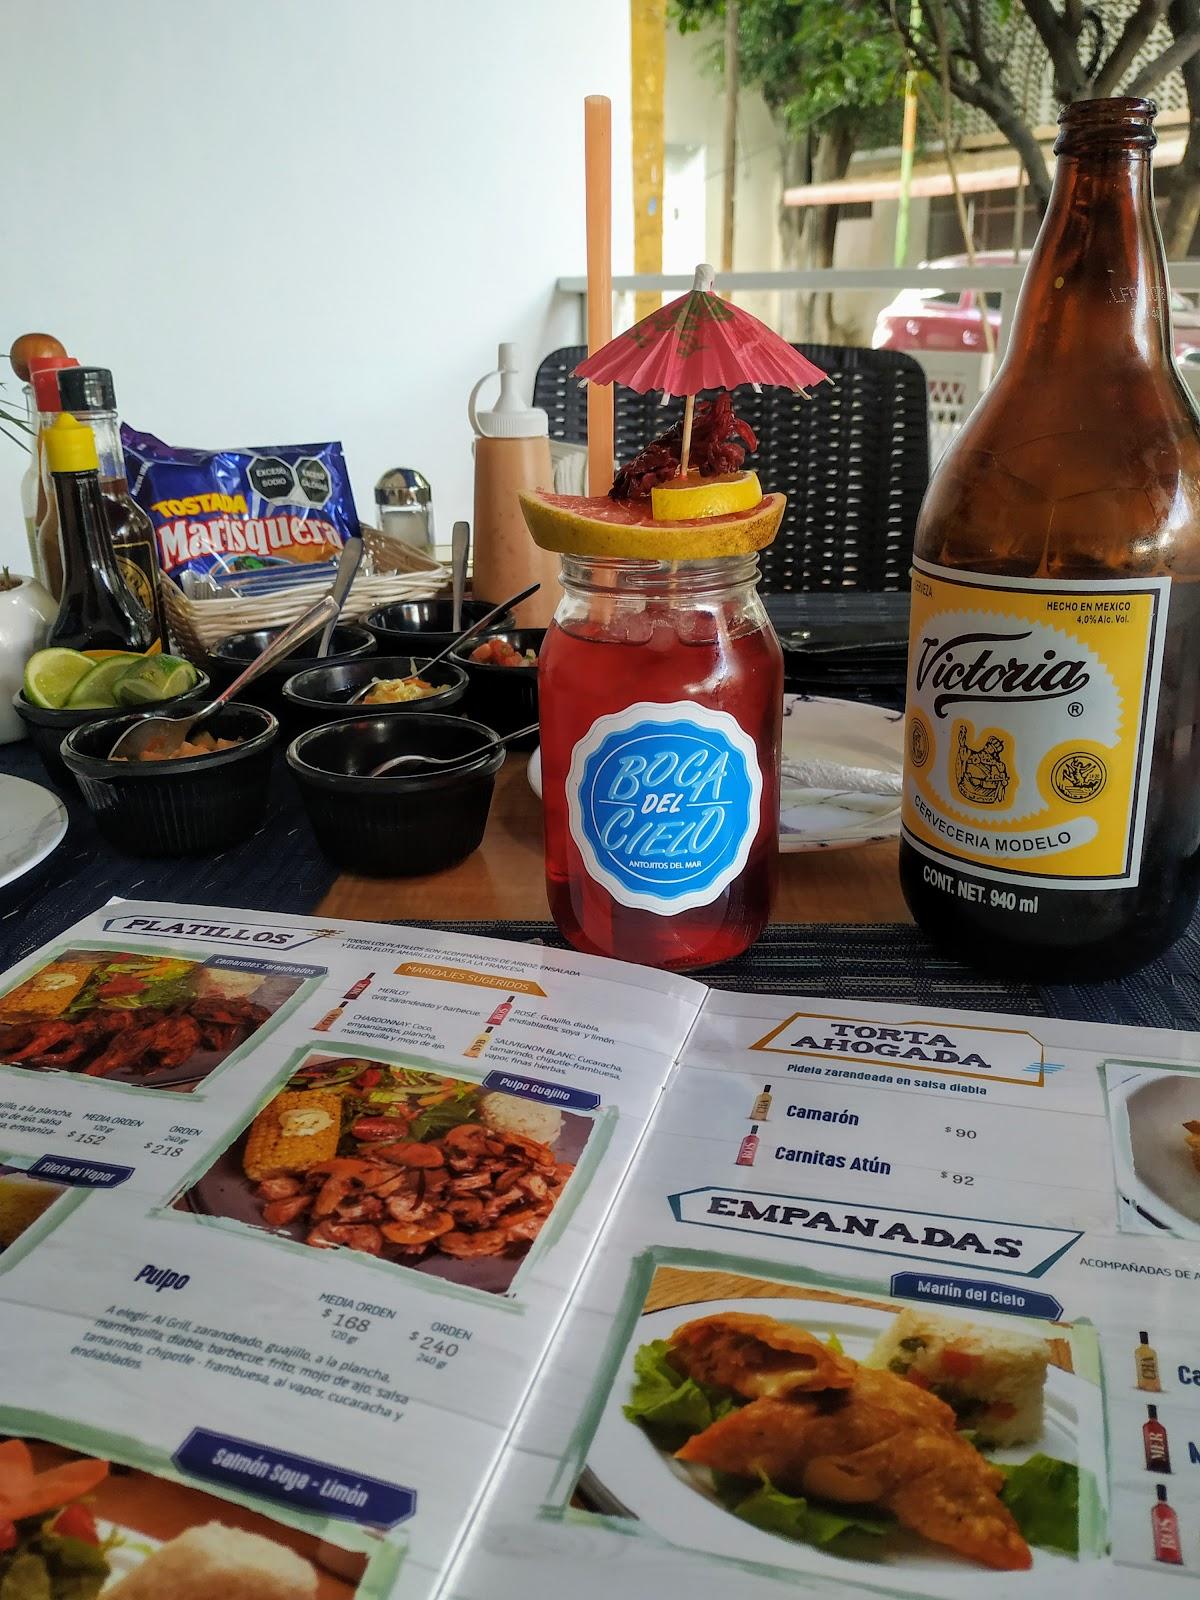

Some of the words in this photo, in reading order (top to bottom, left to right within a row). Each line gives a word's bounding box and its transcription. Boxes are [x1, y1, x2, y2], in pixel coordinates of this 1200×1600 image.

[151, 493, 249, 518] TOSTADA
[157, 515, 345, 574] Marisquera
[1047, 602, 1078, 612] HECHO
[1080, 602, 1093, 612] EN
[1094, 602, 1131, 612] MEXICO
[916, 631, 1090, 702] Victoria
[608, 749, 730, 802] BOCA
[641, 793, 684, 814] DEL
[601, 806, 725, 856] CIELO
[914, 795, 991, 850] CERVECERIA
[995, 831, 1071, 851] MODELO
[629, 860, 668, 870] ANTOJITOS
[669, 861, 684, 870] DEL
[685, 860, 702, 869] MAR
[923, 865, 954, 894] CONT.
[958, 882, 986, 904] NET.
[990, 889, 1016, 911] 940
[1019, 896, 1038, 914] ml
[124, 919, 295, 945] PLATILLOS
[346, 938, 372, 946] TODOS
[386, 942, 426, 952] PLATILLOS
[540, 964, 581, 977] ENSALADA
[373, 946, 396, 954] ELOTE
[396, 950, 434, 960] AMARILLO
[406, 966, 465, 980] MARIDAJES
[466, 974, 530, 991] SUGERIDOS
[378, 987, 410, 997] MERLOT
[389, 997, 436, 1009] zarandeado
[340, 1028, 390, 1040] mantequilla
[396, 1036, 419, 1046] mojo
[560, 1028, 581, 1038] soya
[830, 1022, 957, 1048] TORTA
[494, 1038, 546, 1054] SAUVIGNON
[790, 1036, 992, 1069] AHOGADA
[510, 1056, 532, 1067] finas
[500, 1077, 530, 1092] Pulpo
[530, 1084, 571, 1101] Guajillo
[824, 1068, 894, 1084] zarandeada
[896, 1076, 911, 1086] en
[914, 1076, 946, 1090] salsa
[949, 1082, 988, 1096] diabla
[38, 1118, 62, 1126] salsa
[82, 1112, 110, 1122] MEDIA
[111, 1117, 144, 1128] ORDEN
[786, 1104, 860, 1126] Camarón
[168, 1125, 204, 1136] ORDEN
[38, 1162, 68, 1175] Filete
[69, 1167, 83, 1177] al
[82, 1168, 116, 1182] Vapor
[774, 1145, 846, 1170] Carnitas
[848, 1154, 892, 1177] Atún
[706, 1196, 1023, 1259] EMPANADAS
[133, 1263, 191, 1293] Pulpo
[1080, 1257, 1172, 1277] ACOMPAÑADAS
[1174, 1269, 1192, 1280] DE
[318, 1292, 355, 1310] MEDIA
[356, 1302, 398, 1320] ORDEN
[965, 1286, 988, 1302] del
[990, 1291, 1026, 1308] Cielo
[151, 1314, 166, 1324] Al
[326, 1355, 338, 1368] la
[430, 1321, 473, 1341] ORDEN
[146, 1346, 196, 1365] chipotle
[274, 1376, 288, 1388] al
[328, 1392, 393, 1418] cucaracha
[392, 1411, 405, 1422] y
[300, 1366, 331, 1383] mojo
[332, 1375, 350, 1388] de
[376, 1387, 410, 1405] salsa
[211, 1447, 270, 1478] Salmón
[269, 1463, 311, 1492] Soya
[319, 1478, 369, 1508] Limón
